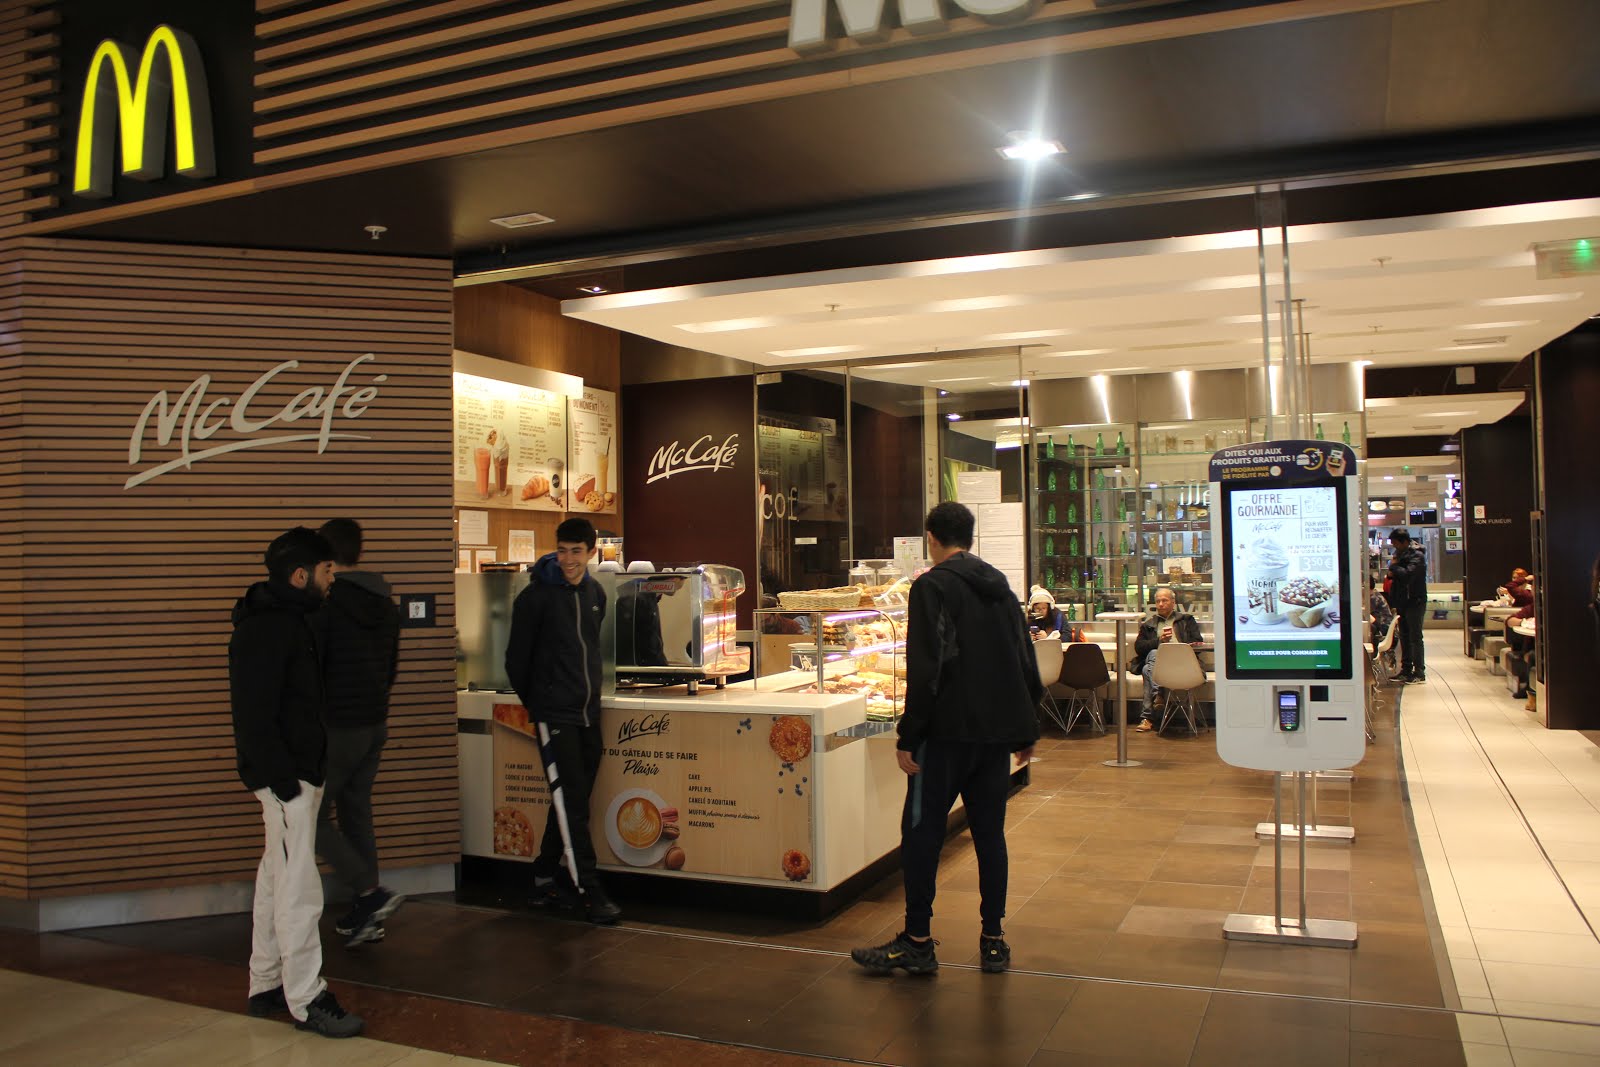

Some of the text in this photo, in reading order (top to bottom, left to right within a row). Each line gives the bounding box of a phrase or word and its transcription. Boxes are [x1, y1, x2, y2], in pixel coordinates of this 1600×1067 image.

[124, 353, 388, 490] McCafé
[1225, 447, 1282, 457] DITES OUI AUX
[646, 433, 739, 485] McCafé
[1212, 457, 1252, 466] PRODUITS
[1253, 455, 1291, 464] GRATUITS
[1251, 493, 1283, 505] OFFRE
[1237, 504, 1299, 517] GOURMANDE
[618, 713, 671, 745] McCafé
[609, 748, 620, 757] DU
[621, 748, 652, 758] GÂTEAU
[653, 751, 664, 759] DE
[665, 751, 675, 760] SE
[676, 752, 698, 761] FAIRE
[623, 759, 660, 776] Plaisir
[688, 773, 701, 781] CAKE
[688, 785, 703, 793] APPLE
[688, 796, 737, 807] CANELÉ D'AQUITAINE
[688, 808, 706, 816] MUFFIN
[688, 821, 715, 829] MACARONS
